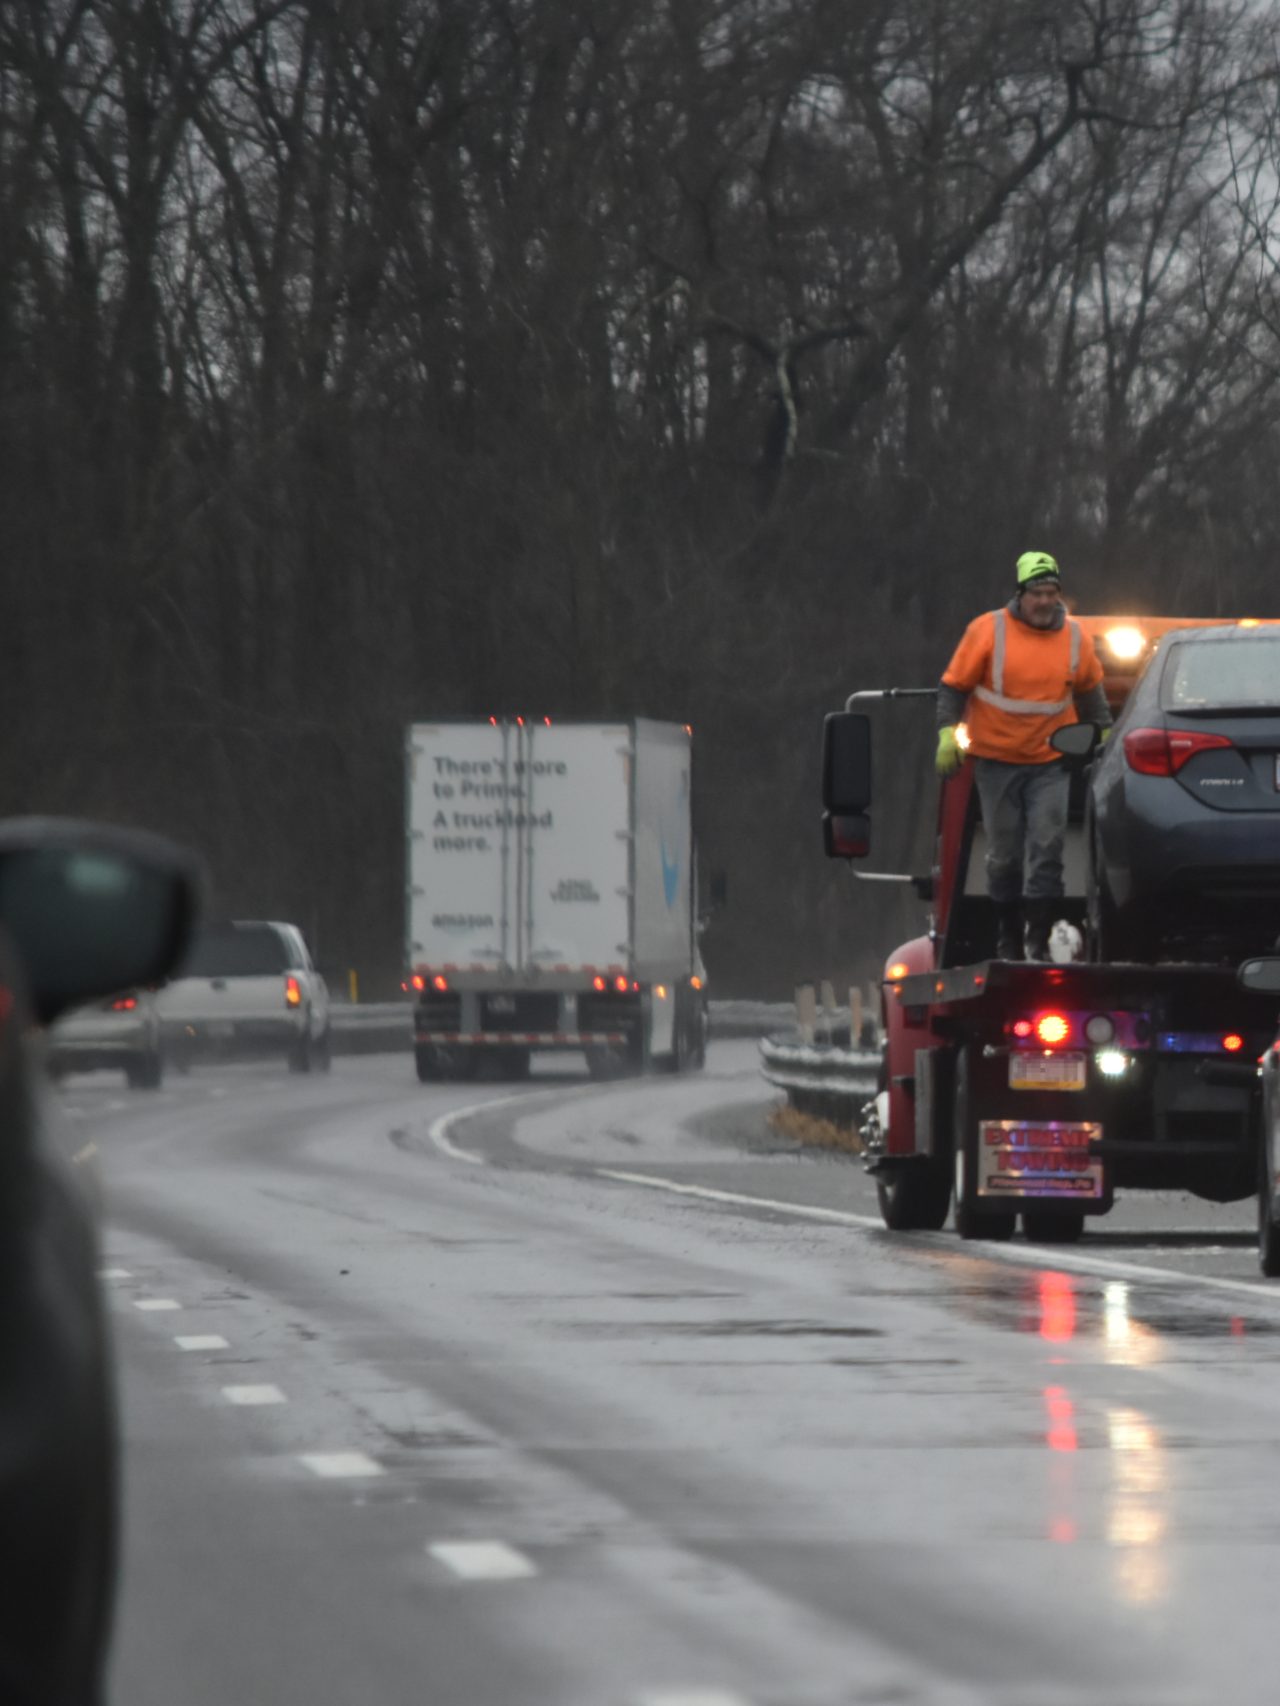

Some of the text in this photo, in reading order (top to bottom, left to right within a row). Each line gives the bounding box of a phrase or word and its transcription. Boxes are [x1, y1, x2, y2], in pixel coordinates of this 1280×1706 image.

[433, 757, 567, 775] There's more
[433, 782, 454, 798] to
[433, 810, 447, 827] A
[433, 836, 491, 850] more.
